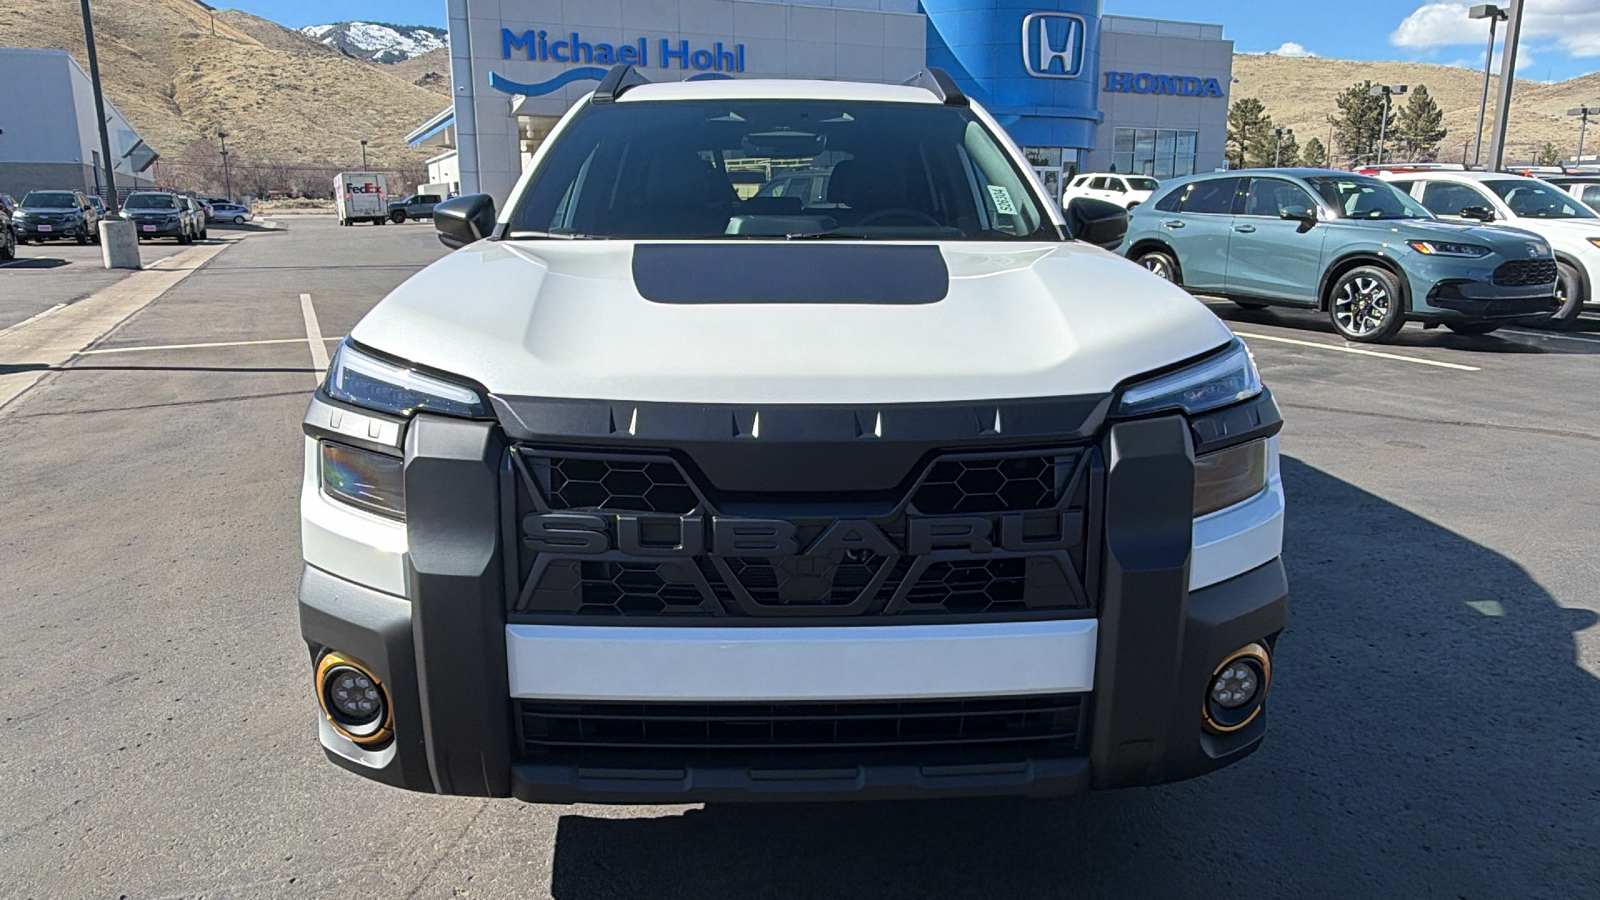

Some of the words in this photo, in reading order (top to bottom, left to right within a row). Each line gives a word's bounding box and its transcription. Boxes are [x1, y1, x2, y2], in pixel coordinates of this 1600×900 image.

[501, 28, 648, 67] Michael
[660, 38, 745, 73] Hohl
[1103, 71, 1225, 98] HONDA
[346, 182, 382, 194] FedEx
[522, 509, 1083, 556] SUBARU
